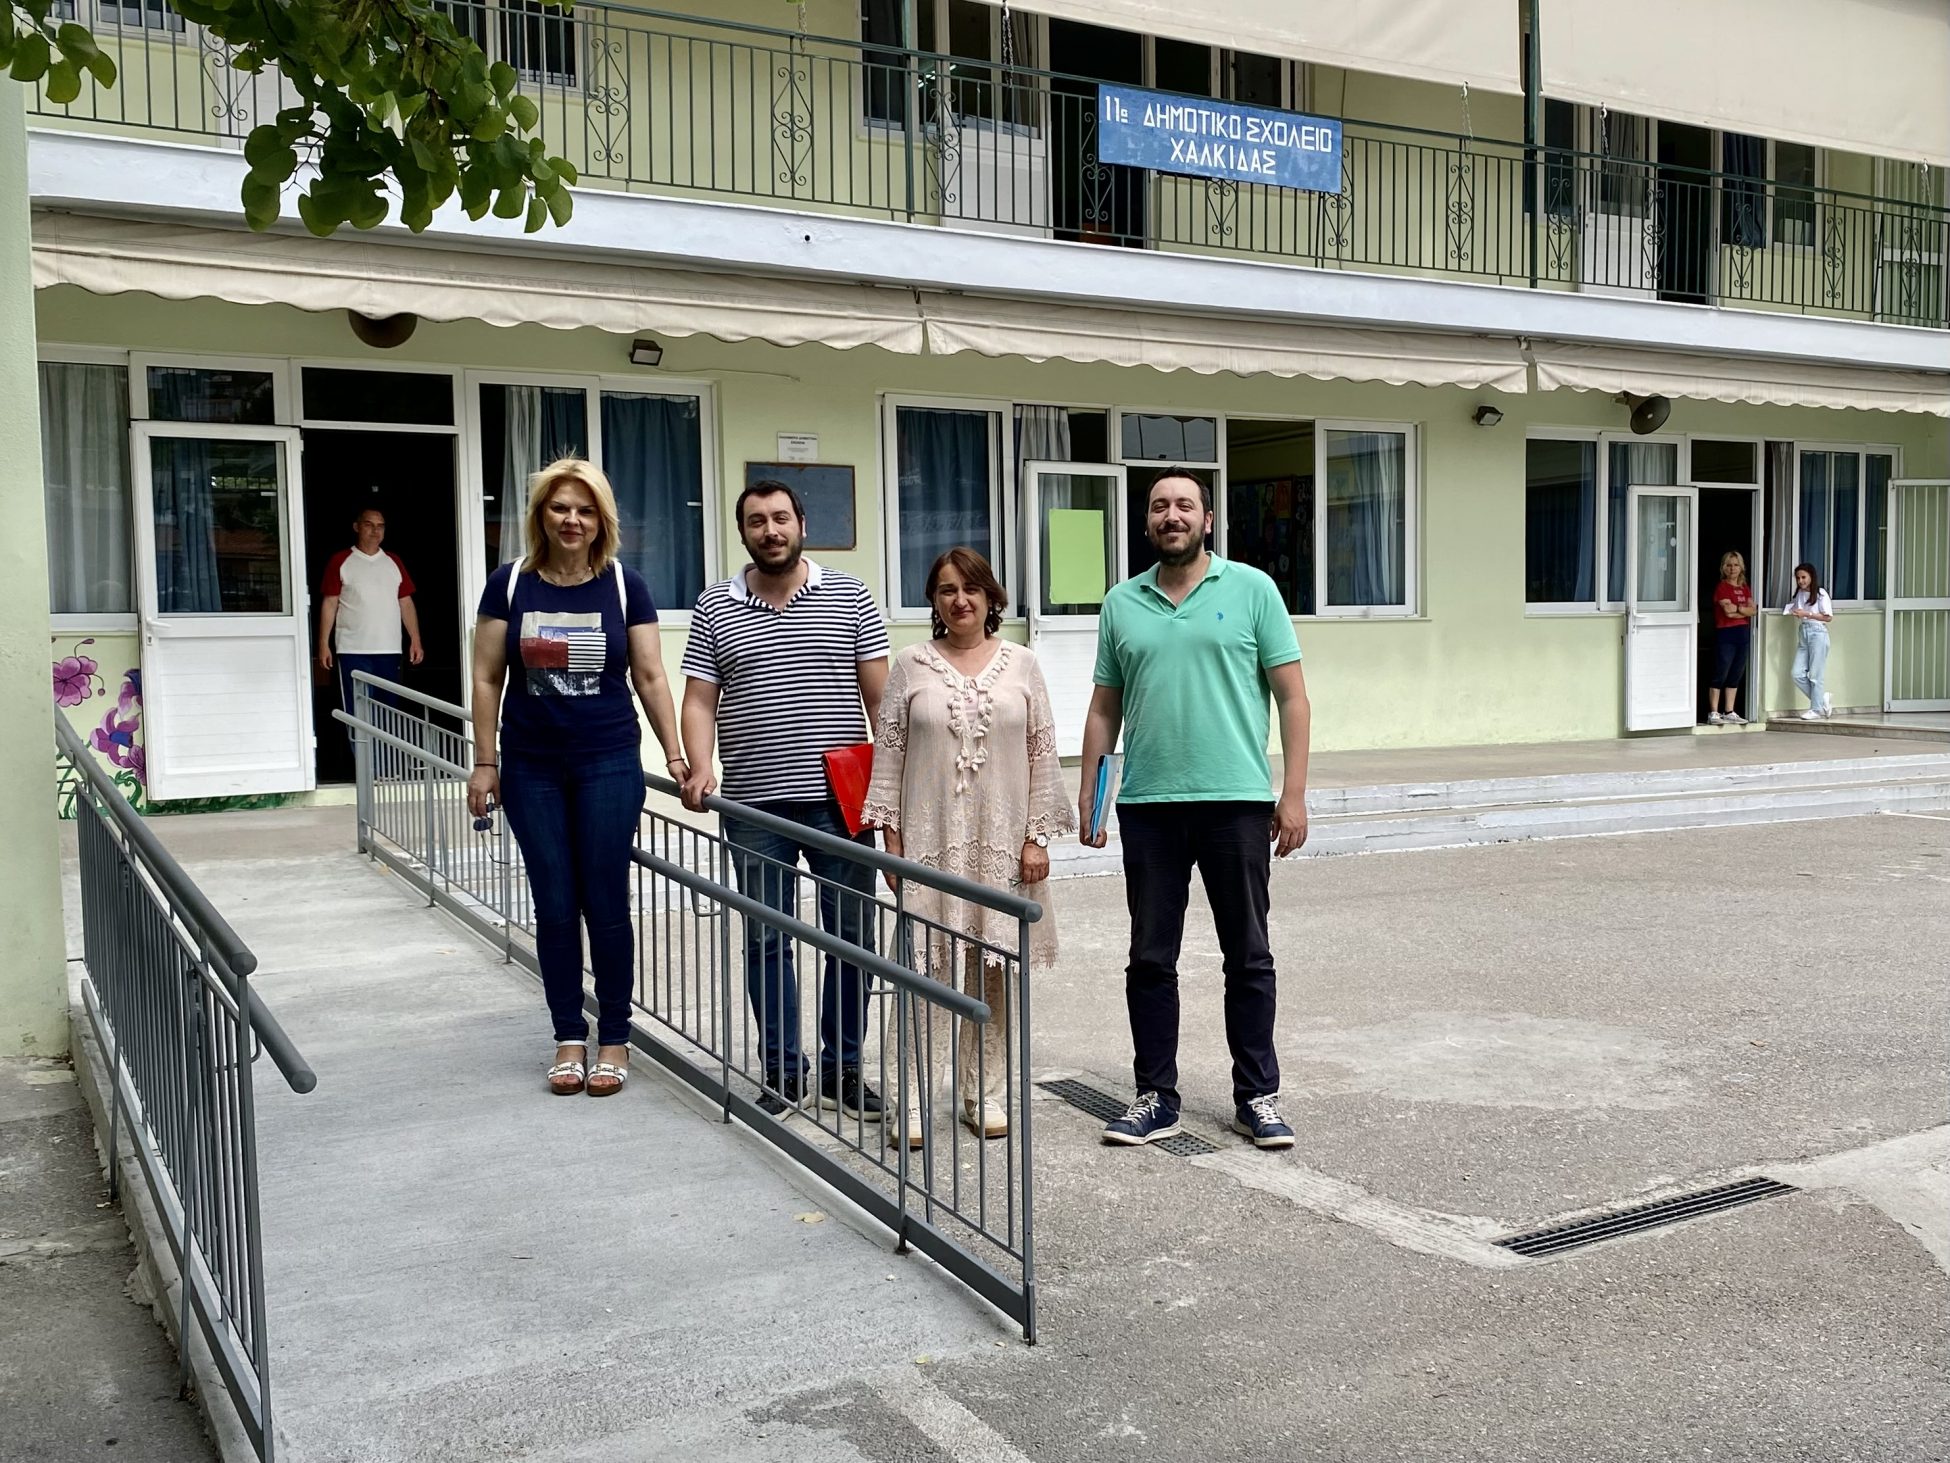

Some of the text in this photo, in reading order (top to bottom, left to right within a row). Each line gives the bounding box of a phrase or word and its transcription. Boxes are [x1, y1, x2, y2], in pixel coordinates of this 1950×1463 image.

[1143, 103, 1241, 140] ΔΗΜΟΤΙΚΟ
[1246, 117, 1332, 153] ΣΧΟΛΕΙΟ
[1171, 137, 1276, 175] ΧΑΛΚΙΔΑΣ
